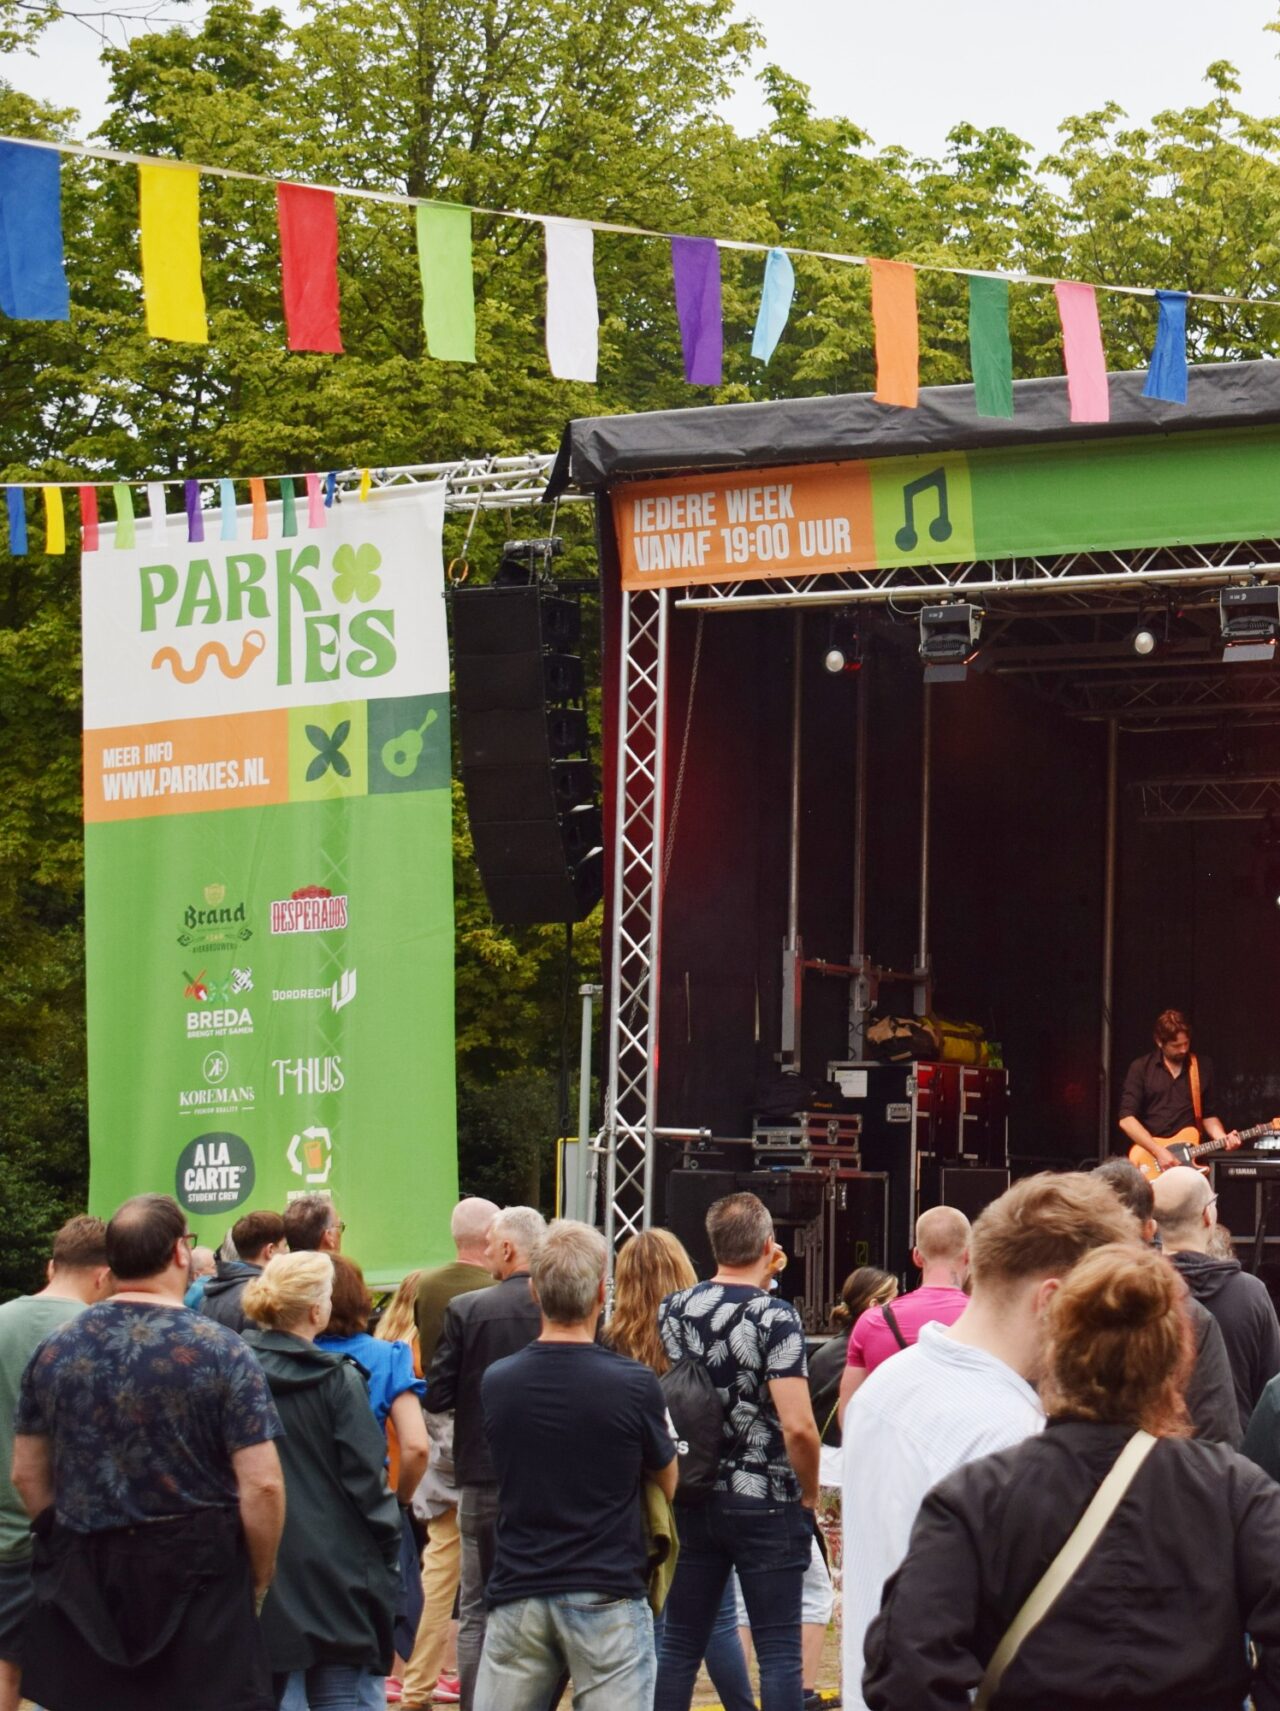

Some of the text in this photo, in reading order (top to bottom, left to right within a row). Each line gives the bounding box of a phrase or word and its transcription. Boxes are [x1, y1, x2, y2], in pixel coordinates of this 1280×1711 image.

[633, 484, 795, 533] IEDERE WEEK
[633, 517, 852, 571] VANAF 19:00 UUR
[102, 741, 173, 768] MEER INFO
[102, 757, 270, 801] WWW.PARKIES.NL
[184, 902, 245, 929] Brand
[272, 896, 347, 932] DESPERADOS
[272, 988, 332, 1001] DORDRECHT
[187, 1008, 253, 1030] BREDA
[193, 1142, 231, 1166] A LA
[184, 1166, 241, 1191] CARTE
[1235, 1167, 1257, 1175] YAMAHA
[188, 1191, 239, 1202] STUDENT CREW
